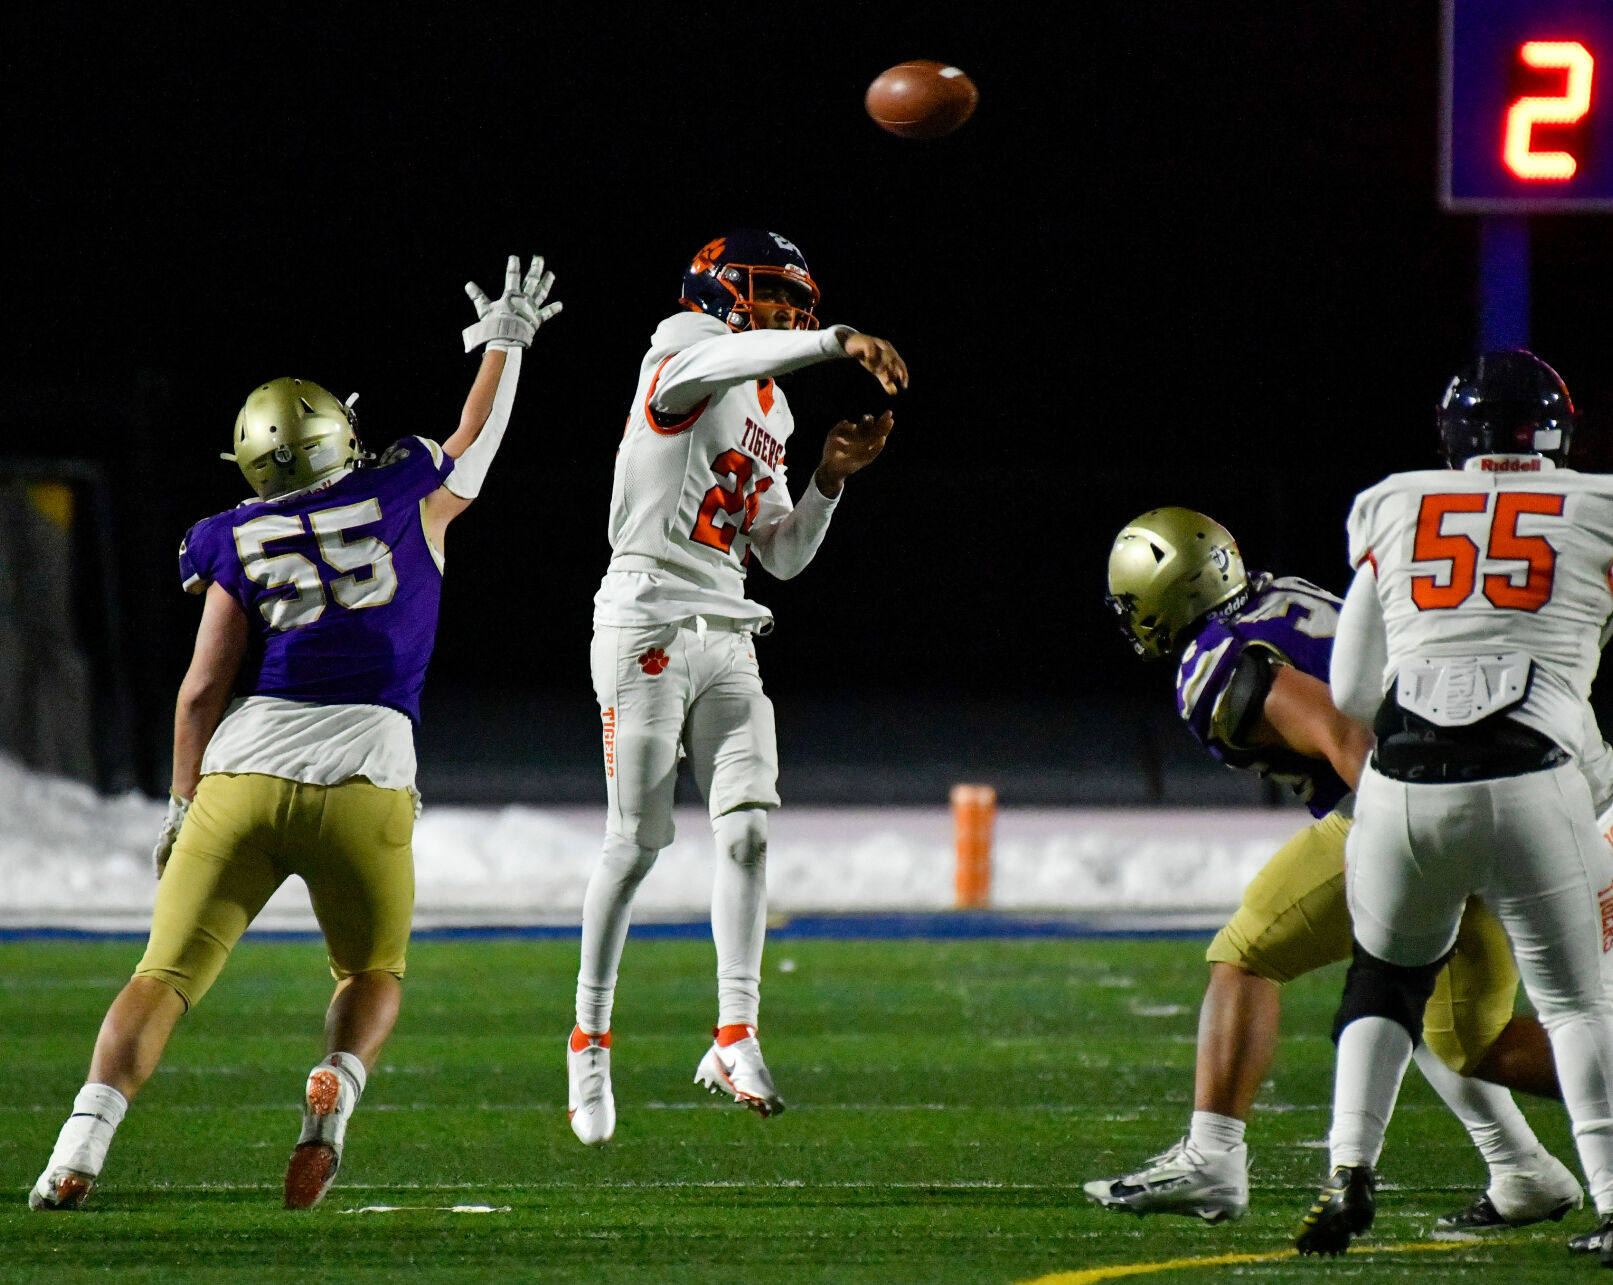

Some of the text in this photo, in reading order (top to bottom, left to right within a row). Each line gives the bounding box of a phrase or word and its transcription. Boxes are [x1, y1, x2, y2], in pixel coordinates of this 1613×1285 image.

[1503, 41, 1594, 180] 2
[741, 417, 784, 473] TIGERS
[1481, 458, 1541, 472] Riddell
[233, 498, 398, 631] 55
[1411, 492, 1567, 613] 55
[602, 706, 616, 778] TIGERS
